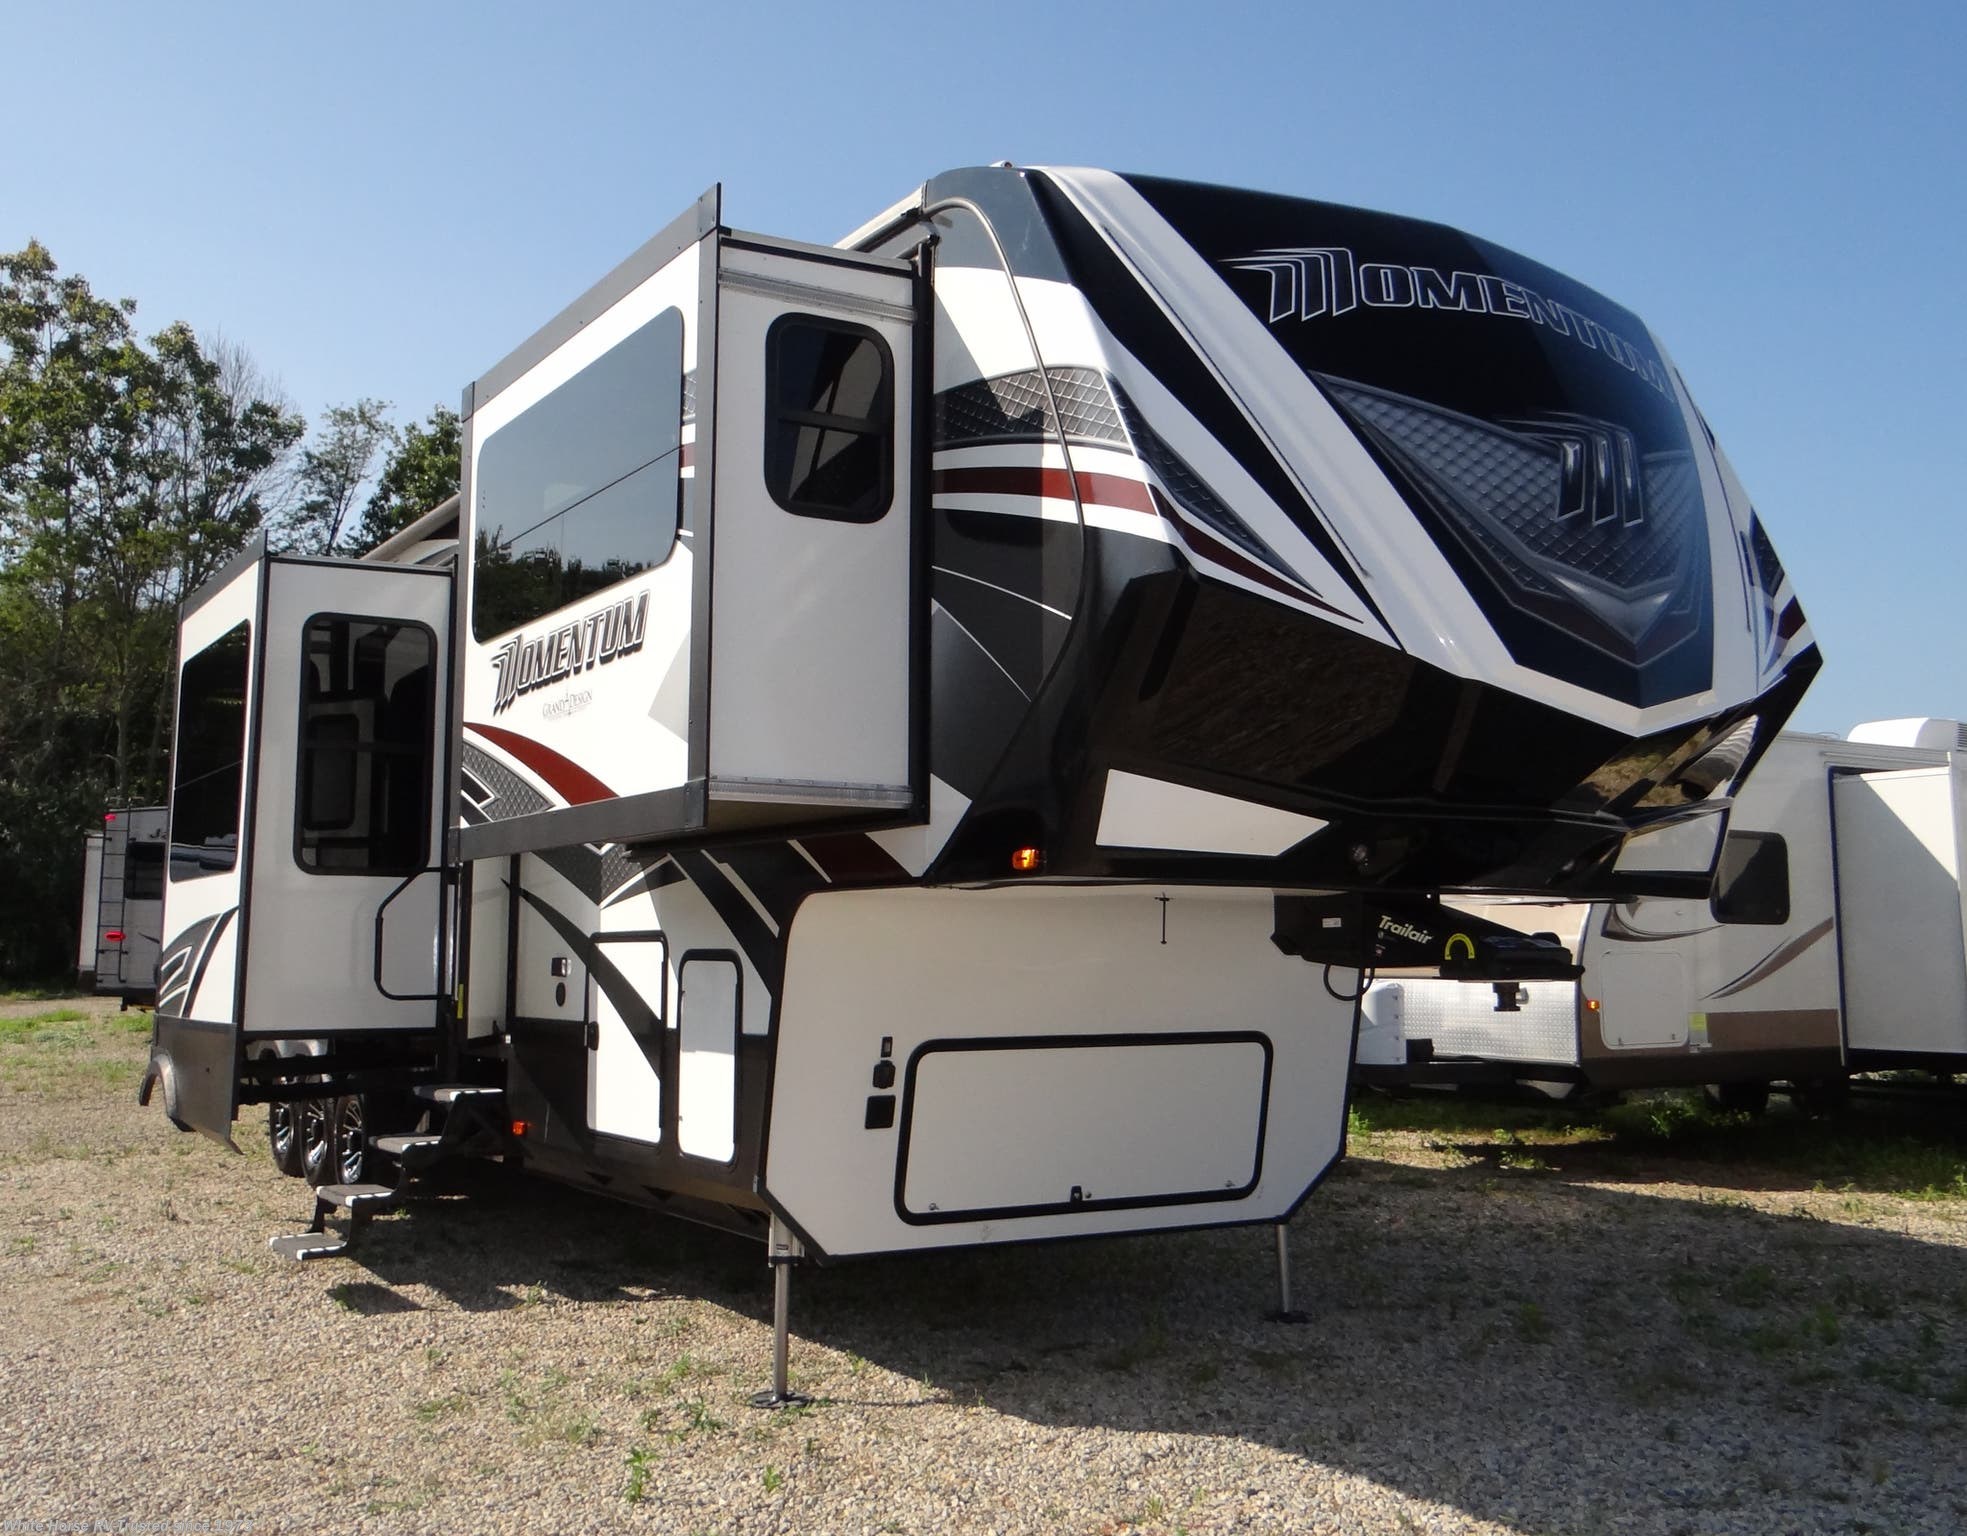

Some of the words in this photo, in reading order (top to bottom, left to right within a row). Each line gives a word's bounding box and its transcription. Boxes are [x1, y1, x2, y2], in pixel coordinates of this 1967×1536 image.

[1217, 247, 1675, 403] MOMENTUM
[490, 588, 651, 717] MOMENTUM
[1378, 914, 1434, 945] Trailair
